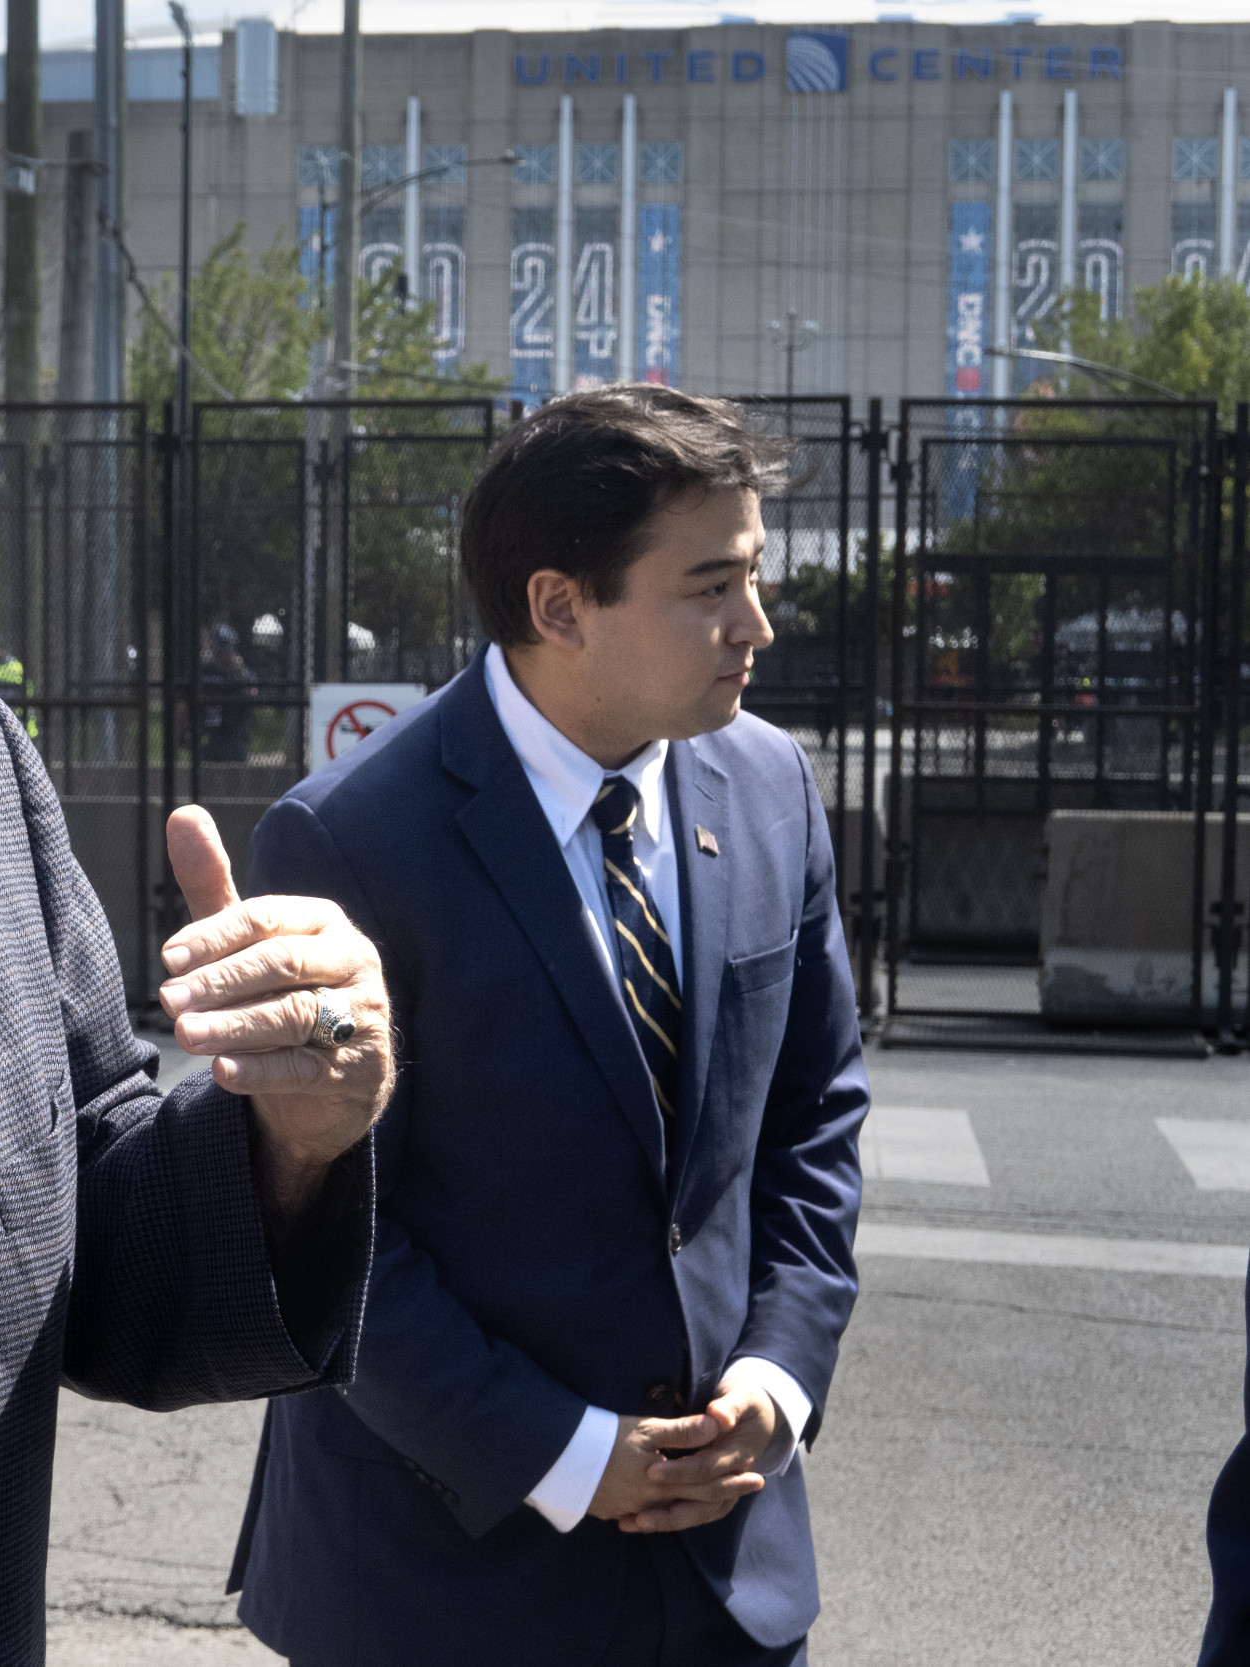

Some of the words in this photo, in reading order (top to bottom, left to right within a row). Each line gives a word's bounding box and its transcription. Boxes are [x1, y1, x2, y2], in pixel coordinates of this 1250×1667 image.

[514, 48, 767, 87] UNITED
[868, 46, 1126, 82] CENTER
[956, 293, 983, 367] DNC
